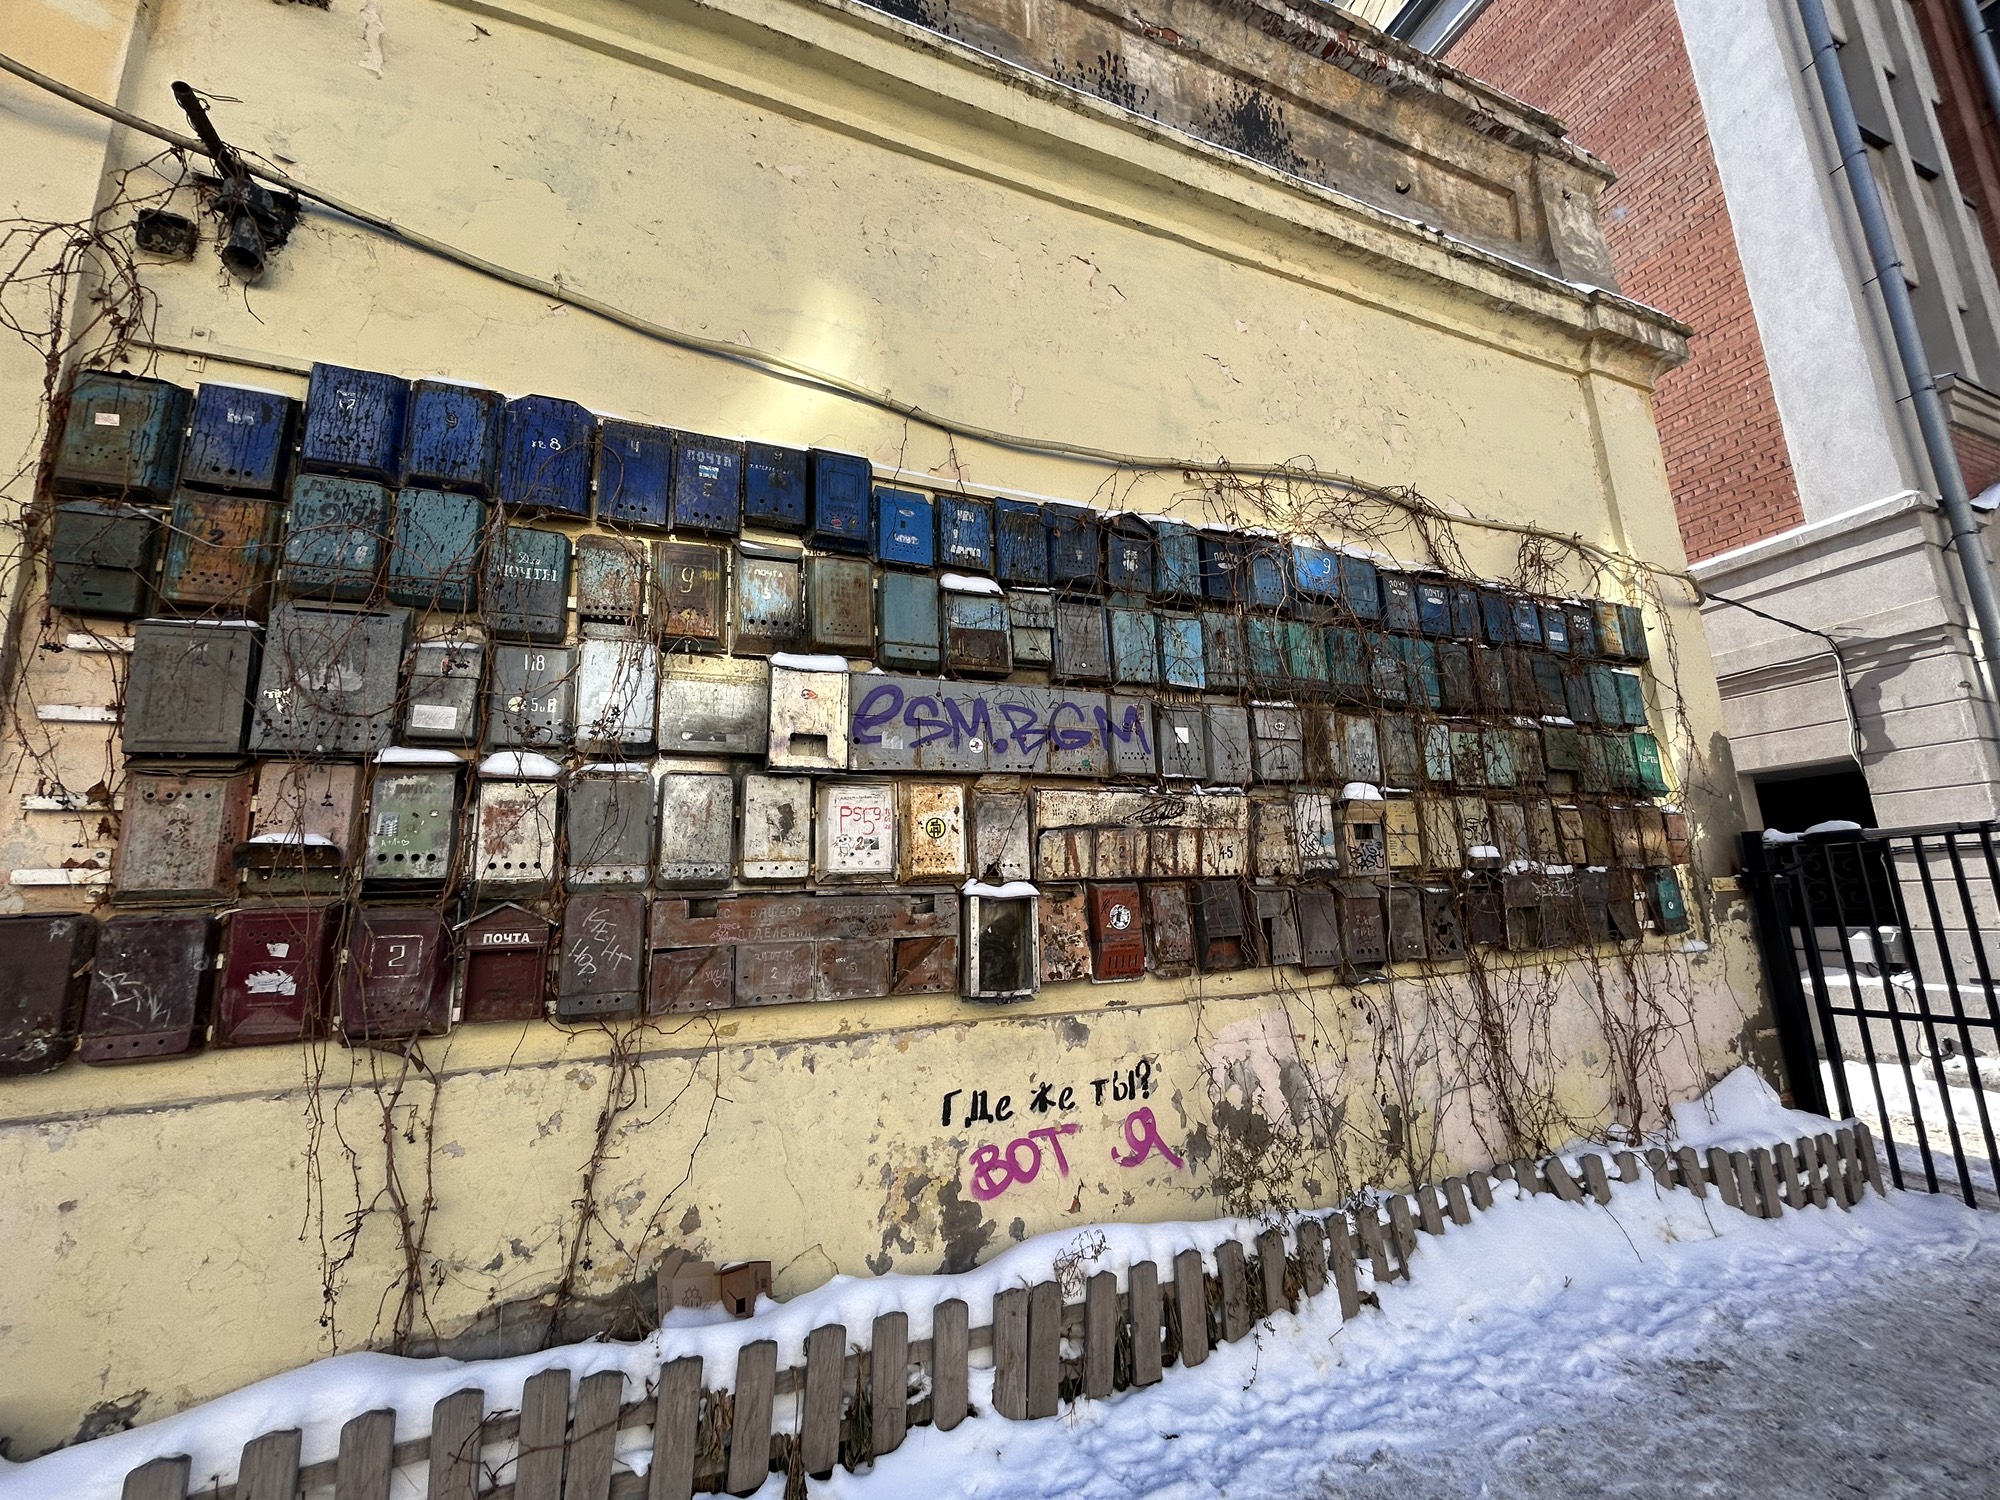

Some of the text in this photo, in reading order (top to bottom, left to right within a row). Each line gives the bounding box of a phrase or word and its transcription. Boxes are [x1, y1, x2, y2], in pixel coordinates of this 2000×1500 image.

[549, 437, 561, 451] 8
[686, 449, 732, 468] ПОЧТА
[208, 528, 225, 546] 2
[681, 566, 695, 593] 9
[754, 568, 784, 578] ПОЧТА
[1424, 588, 1445, 599] ПОЧТА
[483, 932, 530, 944] ПОЧТА
[388, 945, 405, 967] 2
[770, 966, 778, 979] 2
[968, 1106, 1184, 1201] ВОТ Я
